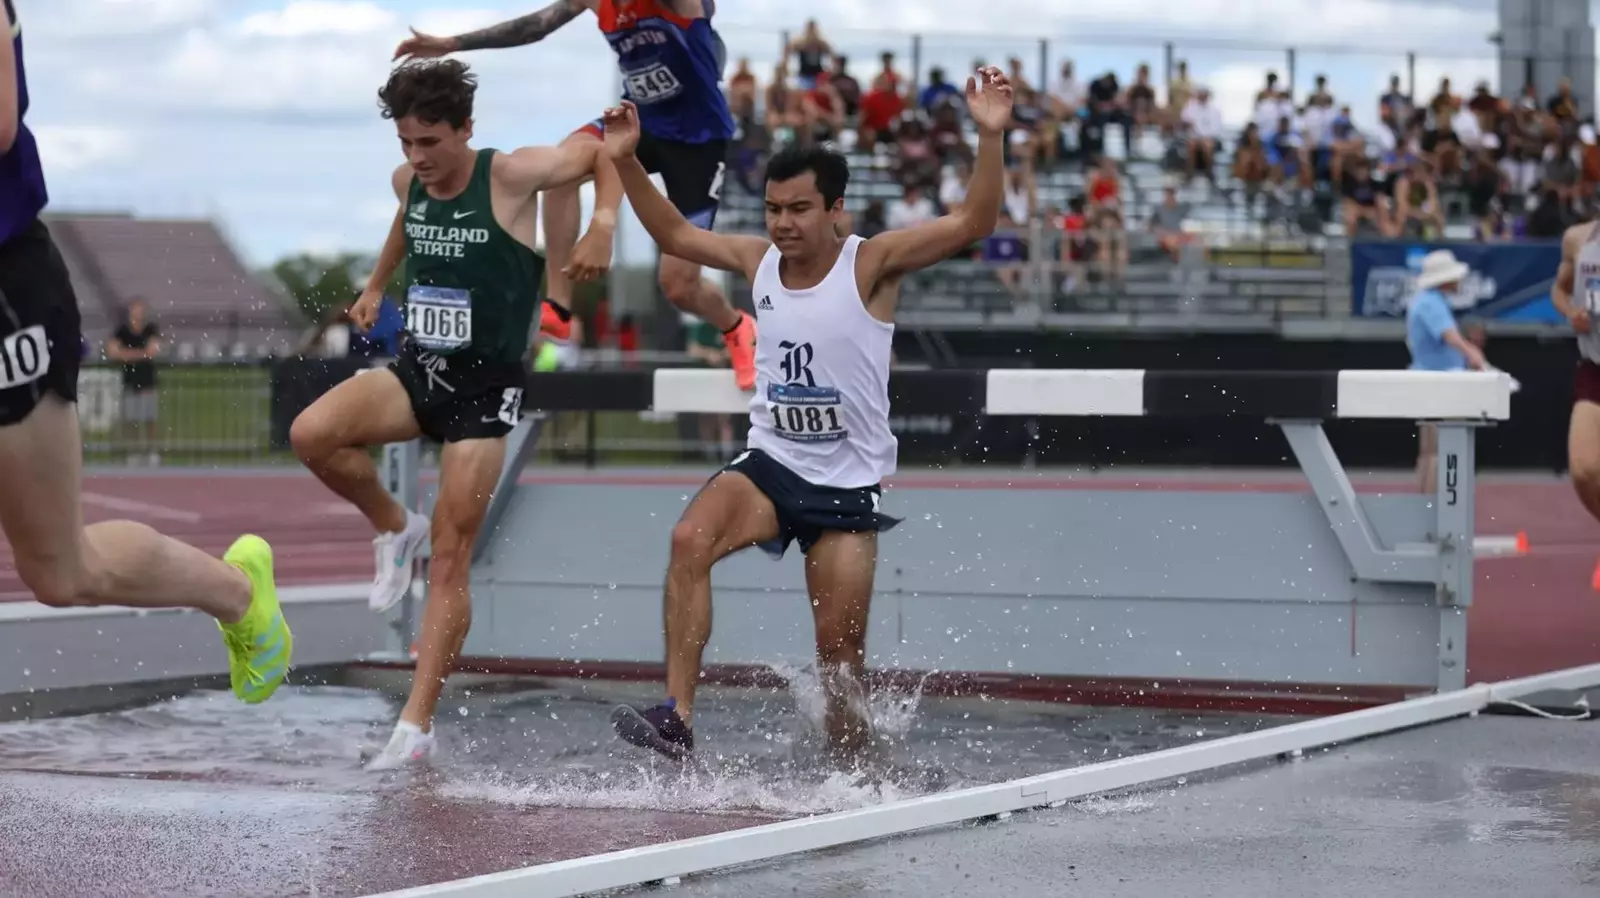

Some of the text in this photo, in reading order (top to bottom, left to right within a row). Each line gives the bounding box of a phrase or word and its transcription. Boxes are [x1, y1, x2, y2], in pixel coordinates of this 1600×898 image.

[405, 223, 489, 243] PORTLAND
[413, 239, 465, 258] STATE
[411, 306, 468, 339] 1066
[770, 405, 843, 433] 1081
[1446, 453, 1457, 506] UCS
